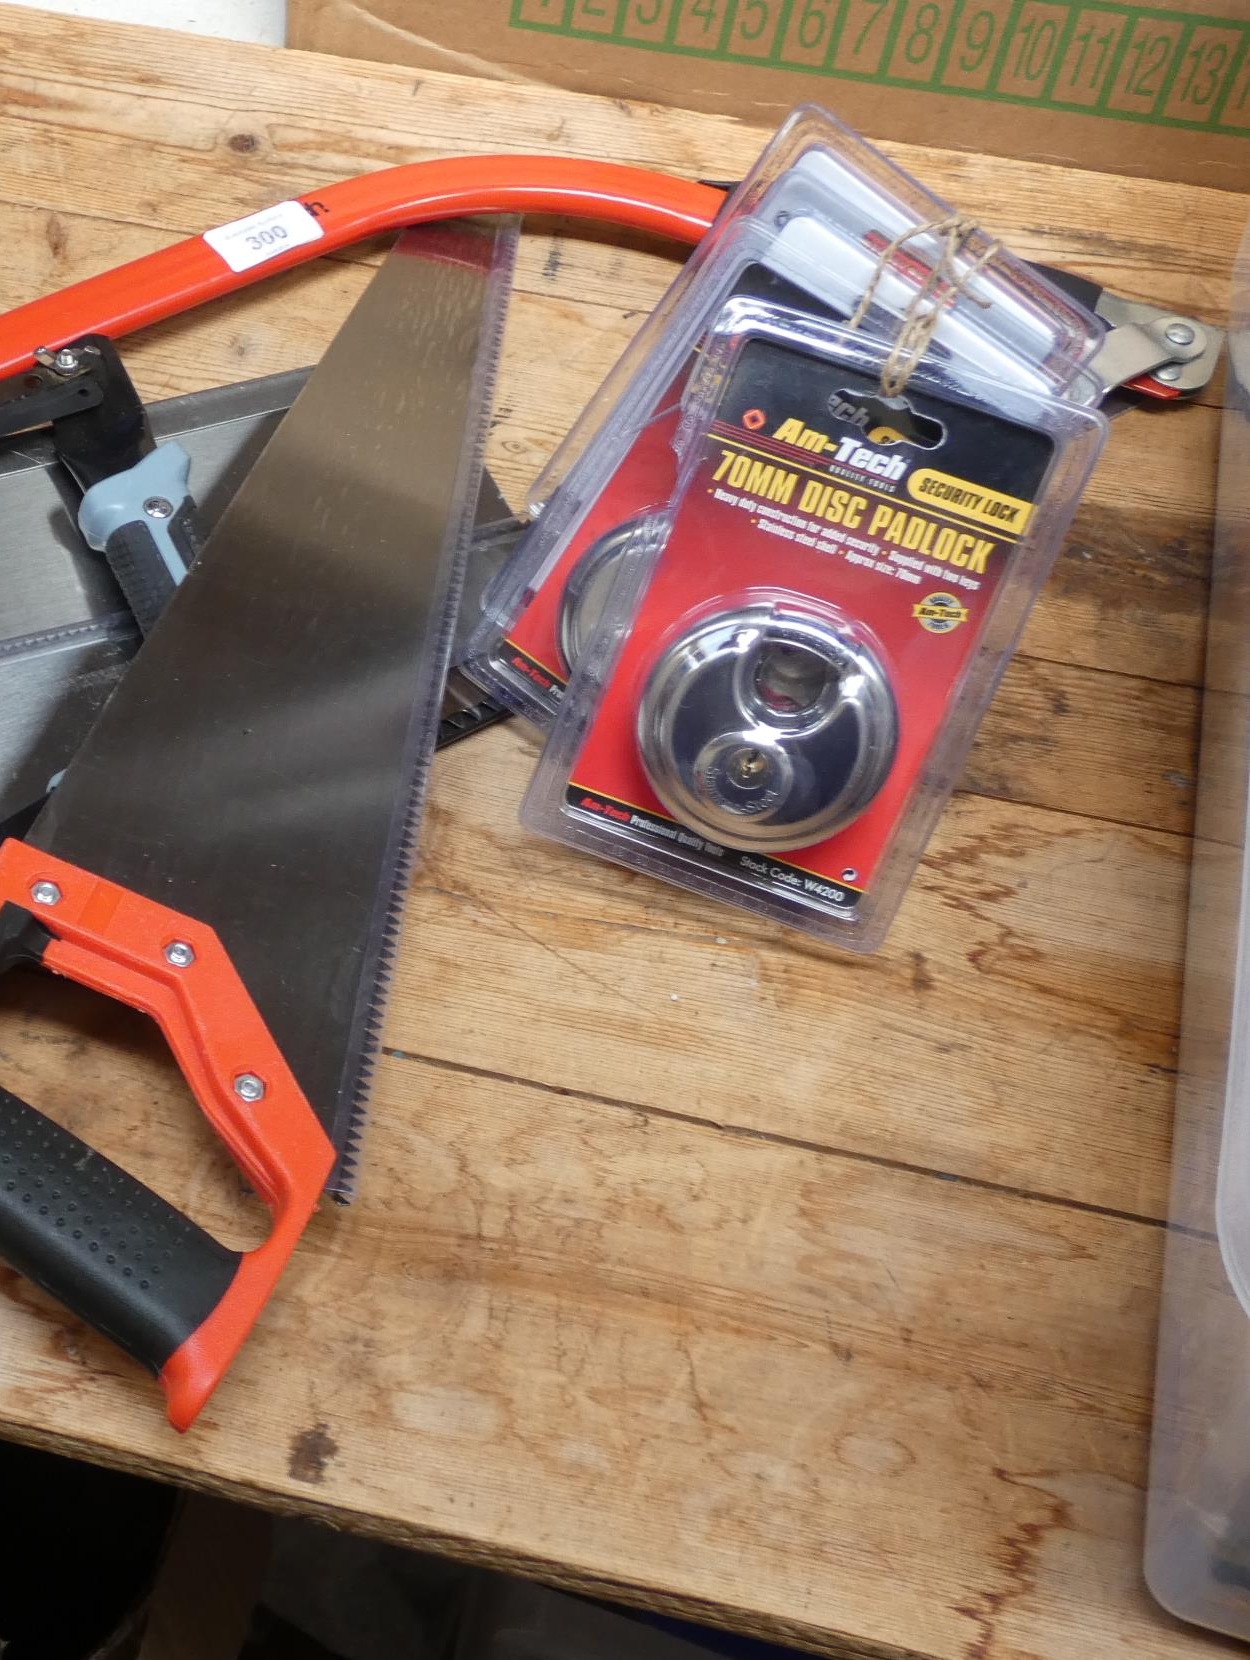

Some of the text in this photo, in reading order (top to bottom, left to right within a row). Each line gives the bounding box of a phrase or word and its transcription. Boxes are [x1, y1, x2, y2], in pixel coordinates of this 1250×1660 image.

[798, 0, 827, 48] 6
[852, 0, 890, 55] 7
[904, 2, 941, 64] 8
[959, 10, 995, 72] 9
[1014, 17, 1057, 81] 10
[1069, 25, 1116, 89] 11
[1125, 31, 1171, 97] 12
[1180, 38, 1228, 105] 13
[245, 225, 288, 250] 300
[772, 417, 908, 481] Am-Tech
[712, 449, 996, 575] 70MM DISC PADLOCK
[714, 488, 881, 556] Heavy duty construction for added security
[918, 476, 1021, 522] SECURITY LOCK
[758, 518, 795, 540] Stainless
[795, 533, 817, 547] steel
[889, 550, 925, 571] Supplied
[924, 564, 943, 577] with
[630, 814, 678, 840] Professional
[677, 832, 704, 851] Quality
[704, 841, 725, 857] Tools
[740, 856, 845, 902] Stock Code: W4200
